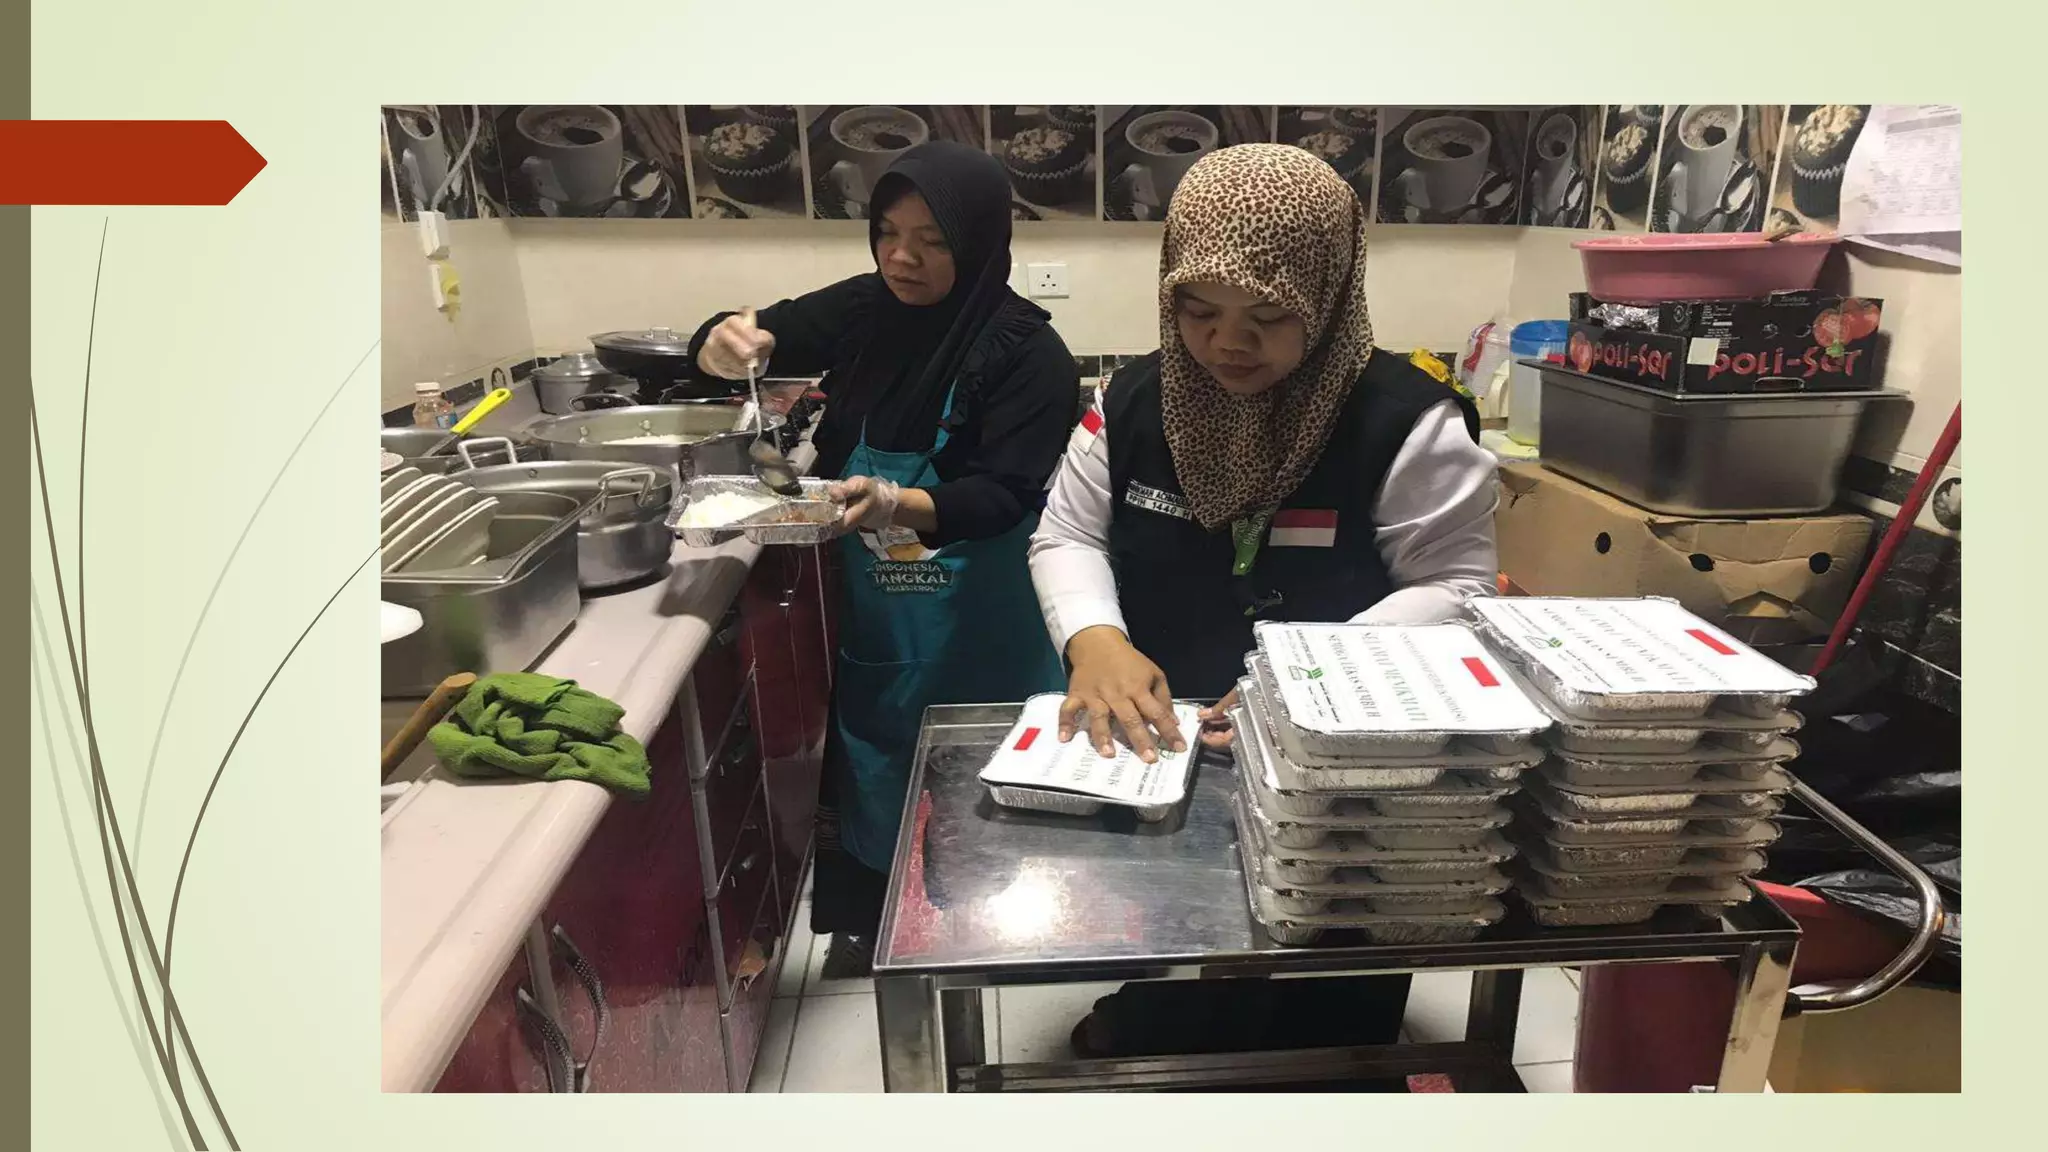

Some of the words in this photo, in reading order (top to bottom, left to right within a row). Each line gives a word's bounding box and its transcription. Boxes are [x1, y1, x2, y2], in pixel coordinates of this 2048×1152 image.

[1152, 501, 1177, 515] 1440
[875, 563, 941, 573] INDONESIA
[872, 572, 947, 584] TANGKAL
